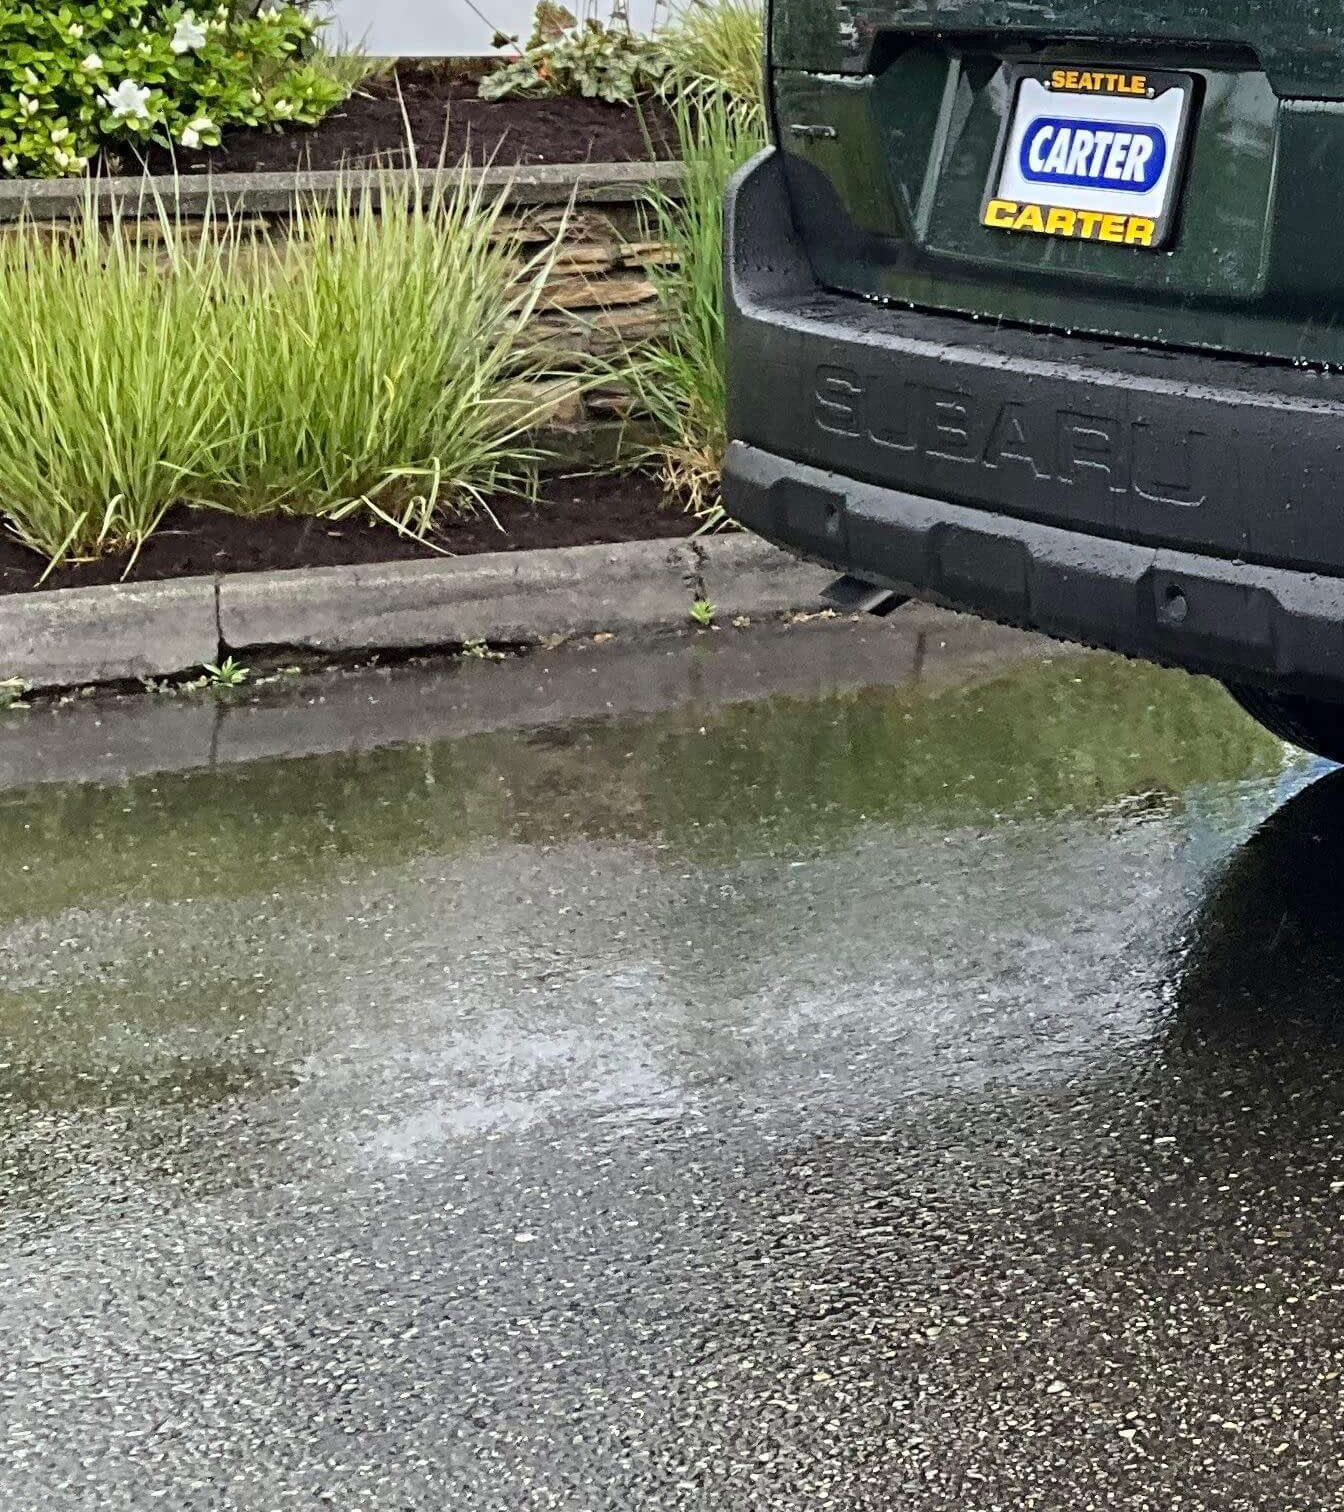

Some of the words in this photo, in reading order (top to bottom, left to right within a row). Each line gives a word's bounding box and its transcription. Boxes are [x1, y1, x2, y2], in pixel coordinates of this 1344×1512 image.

[1051, 70, 1147, 94] SEATTLE
[1028, 124, 1154, 183] CARTER
[984, 199, 1156, 247] CARTER
[815, 362, 1208, 508] SUBARU
